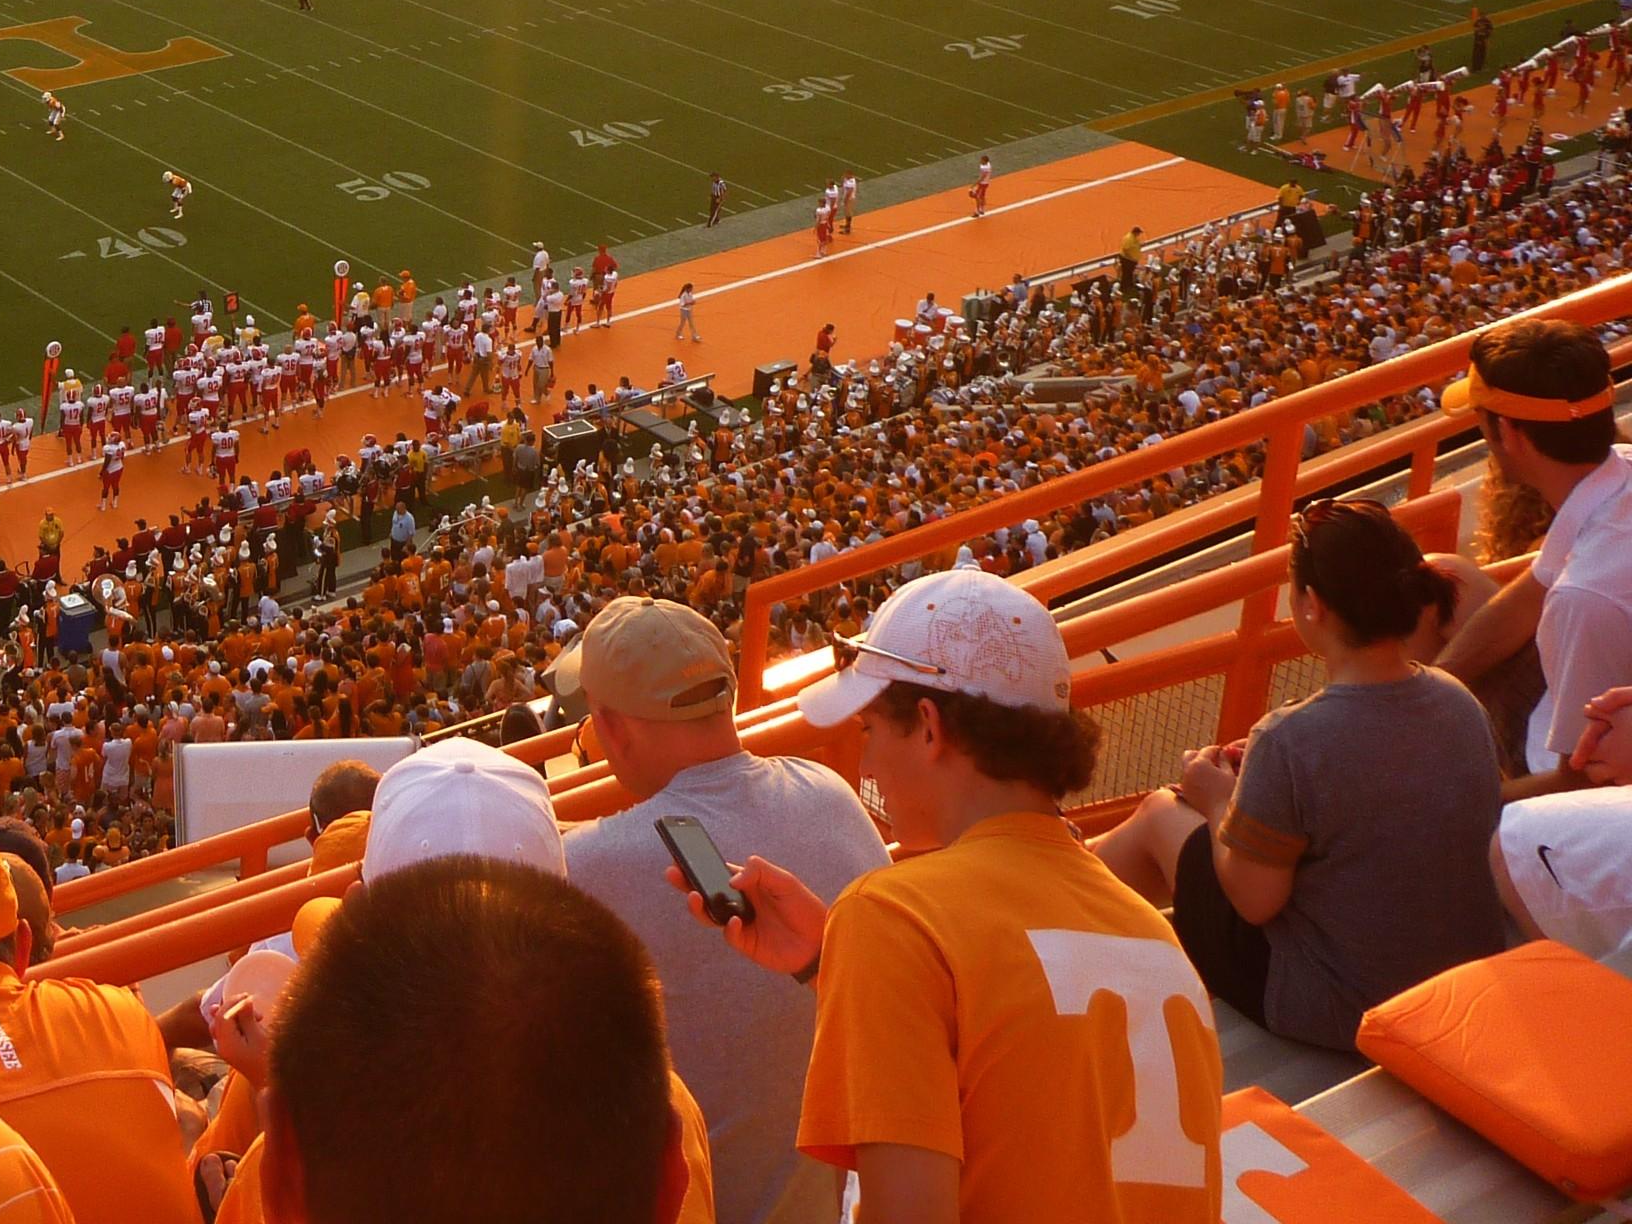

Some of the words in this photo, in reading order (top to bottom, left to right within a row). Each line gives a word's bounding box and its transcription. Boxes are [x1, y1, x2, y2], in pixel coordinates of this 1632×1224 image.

[569, 119, 652, 151] 40
[334, 170, 433, 203] 50
[96, 226, 189, 260] 40
[69, 409, 79, 419] 17
[119, 392, 130, 405] 55
[277, 483, 291, 496] 56
[1025, 929, 1216, 1189] T
